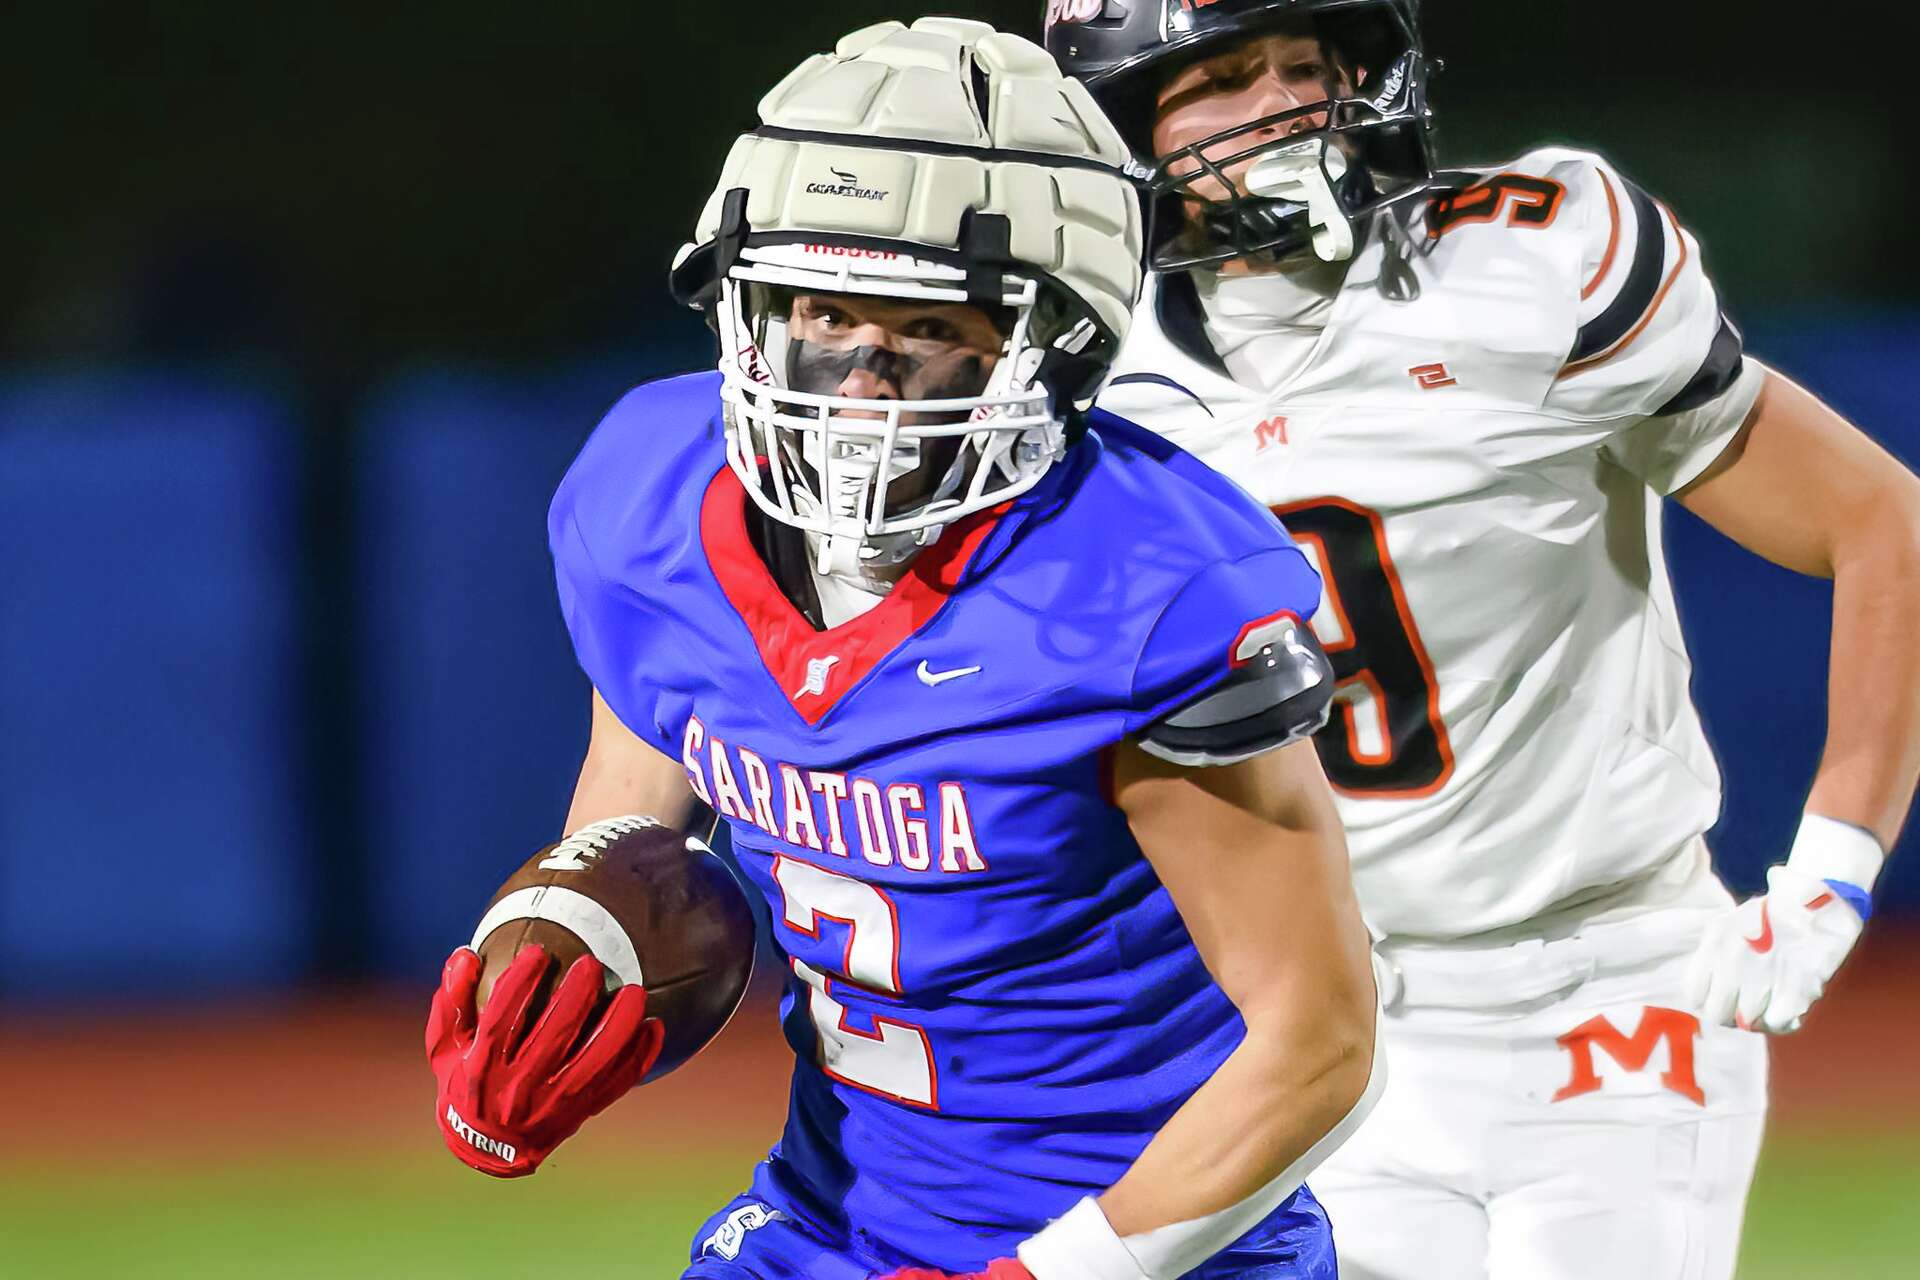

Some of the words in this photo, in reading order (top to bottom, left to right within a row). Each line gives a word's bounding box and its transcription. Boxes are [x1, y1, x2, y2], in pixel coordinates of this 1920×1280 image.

[1253, 415, 1290, 456] M
[1270, 495, 1456, 799] 9
[681, 714, 989, 873] SARATOGA
[772, 853, 939, 1111] 2
[1550, 1004, 1706, 1108] M
[446, 1103, 517, 1164] NXTRND
